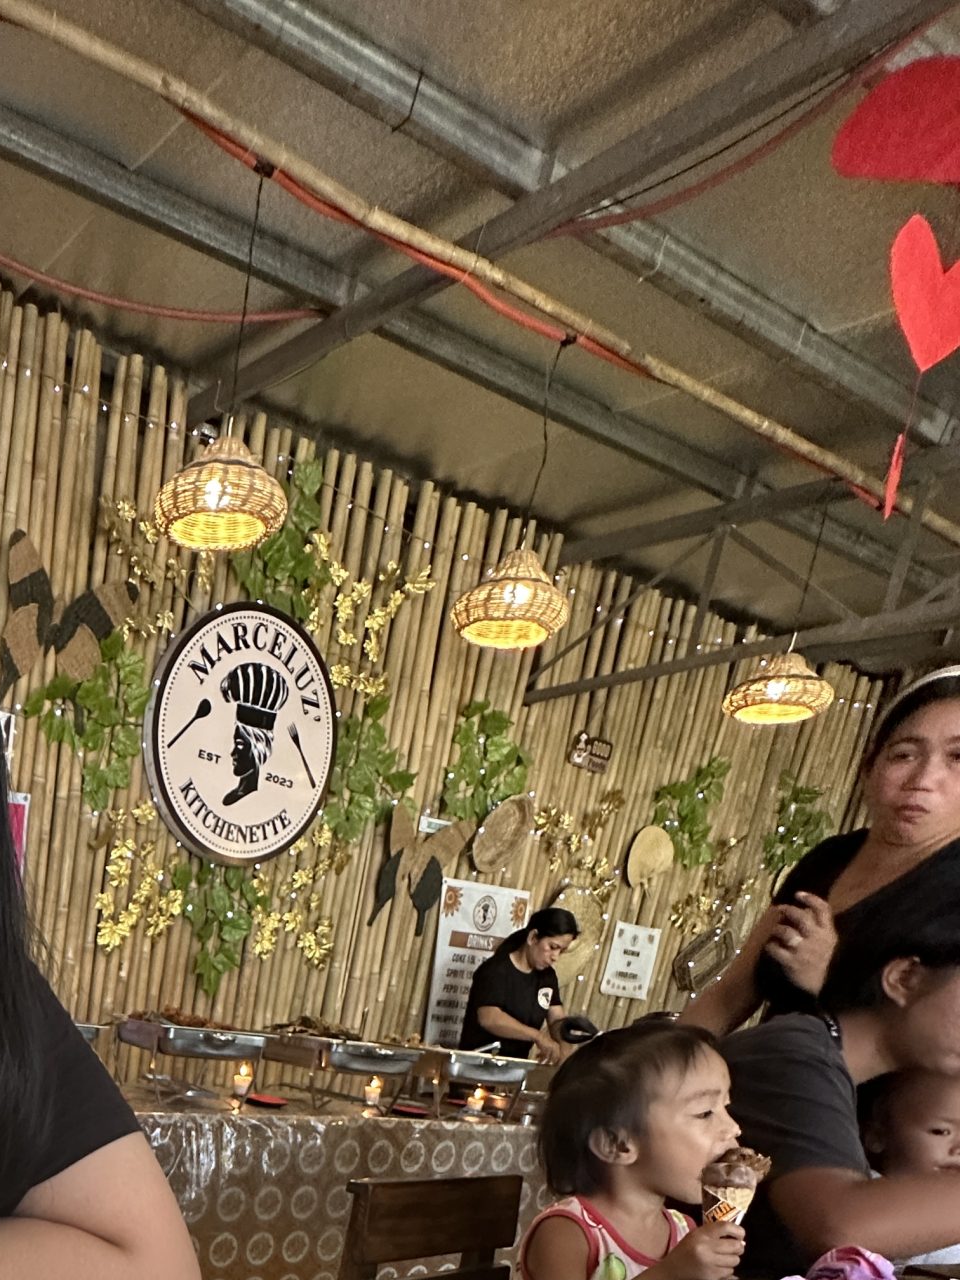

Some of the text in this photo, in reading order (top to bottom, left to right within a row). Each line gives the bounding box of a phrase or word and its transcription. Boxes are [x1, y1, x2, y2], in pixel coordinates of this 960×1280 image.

[198, 749, 294, 789] EST 2023
[178, 777, 292, 844] KITCHENETTE
[467, 933, 494, 951] DRINKS
[451, 953, 467, 964] COKE
